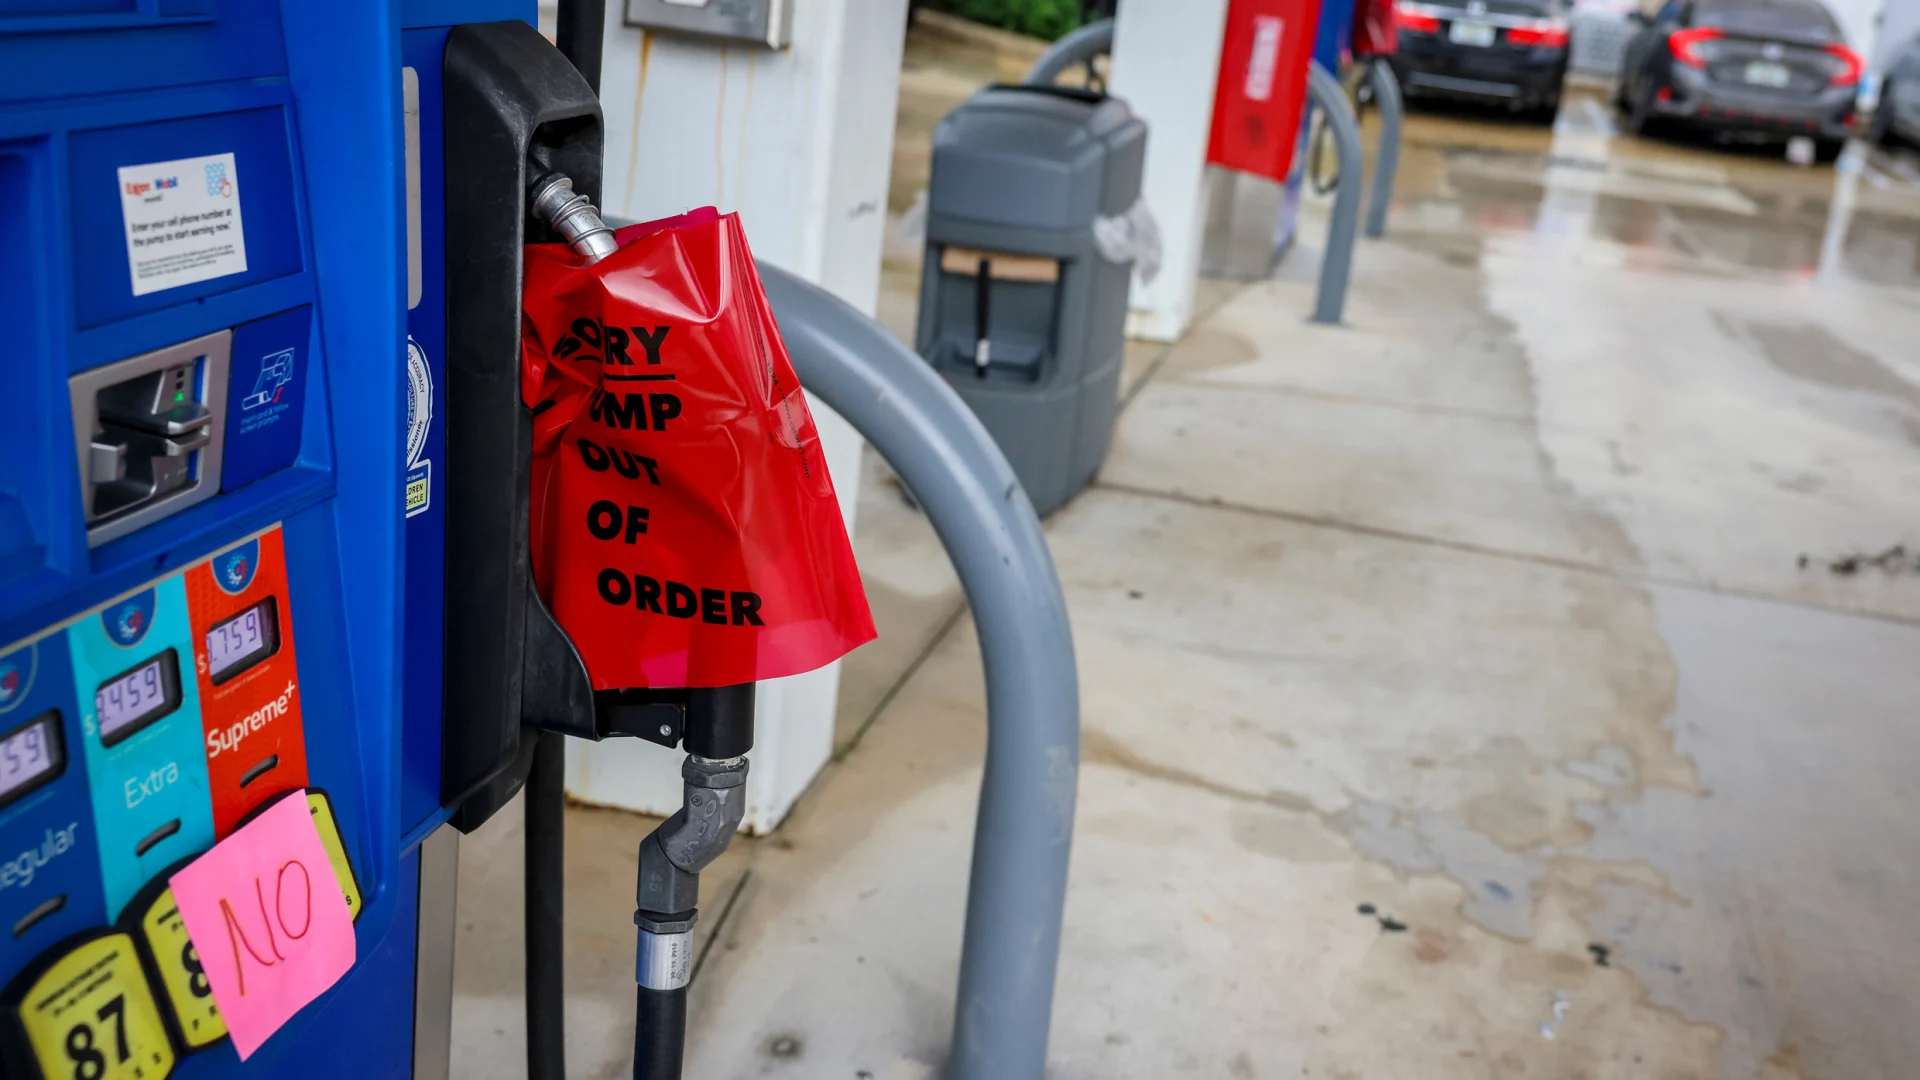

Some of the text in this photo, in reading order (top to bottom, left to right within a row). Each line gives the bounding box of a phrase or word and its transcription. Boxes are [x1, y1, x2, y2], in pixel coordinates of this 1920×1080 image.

[155, 176, 178, 189] Mobil
[146, 235, 164, 246] pump
[166, 233, 173, 241] to
[174, 230, 190, 240] start
[151, 221, 166, 232] your
[180, 213, 200, 226] phone
[201, 209, 225, 220] number
[411, 358, 425, 394] ACCURACY
[406, 419, 423, 457] issioner
[577, 438, 660, 487] OUT
[586, 500, 650, 545] OF
[596, 567, 766, 626] ORDER
[124, 762, 179, 808] Extra
[0, 822, 78, 889] egular
[219, 859, 311, 997] NO
[64, 992, 131, 1080] 87
